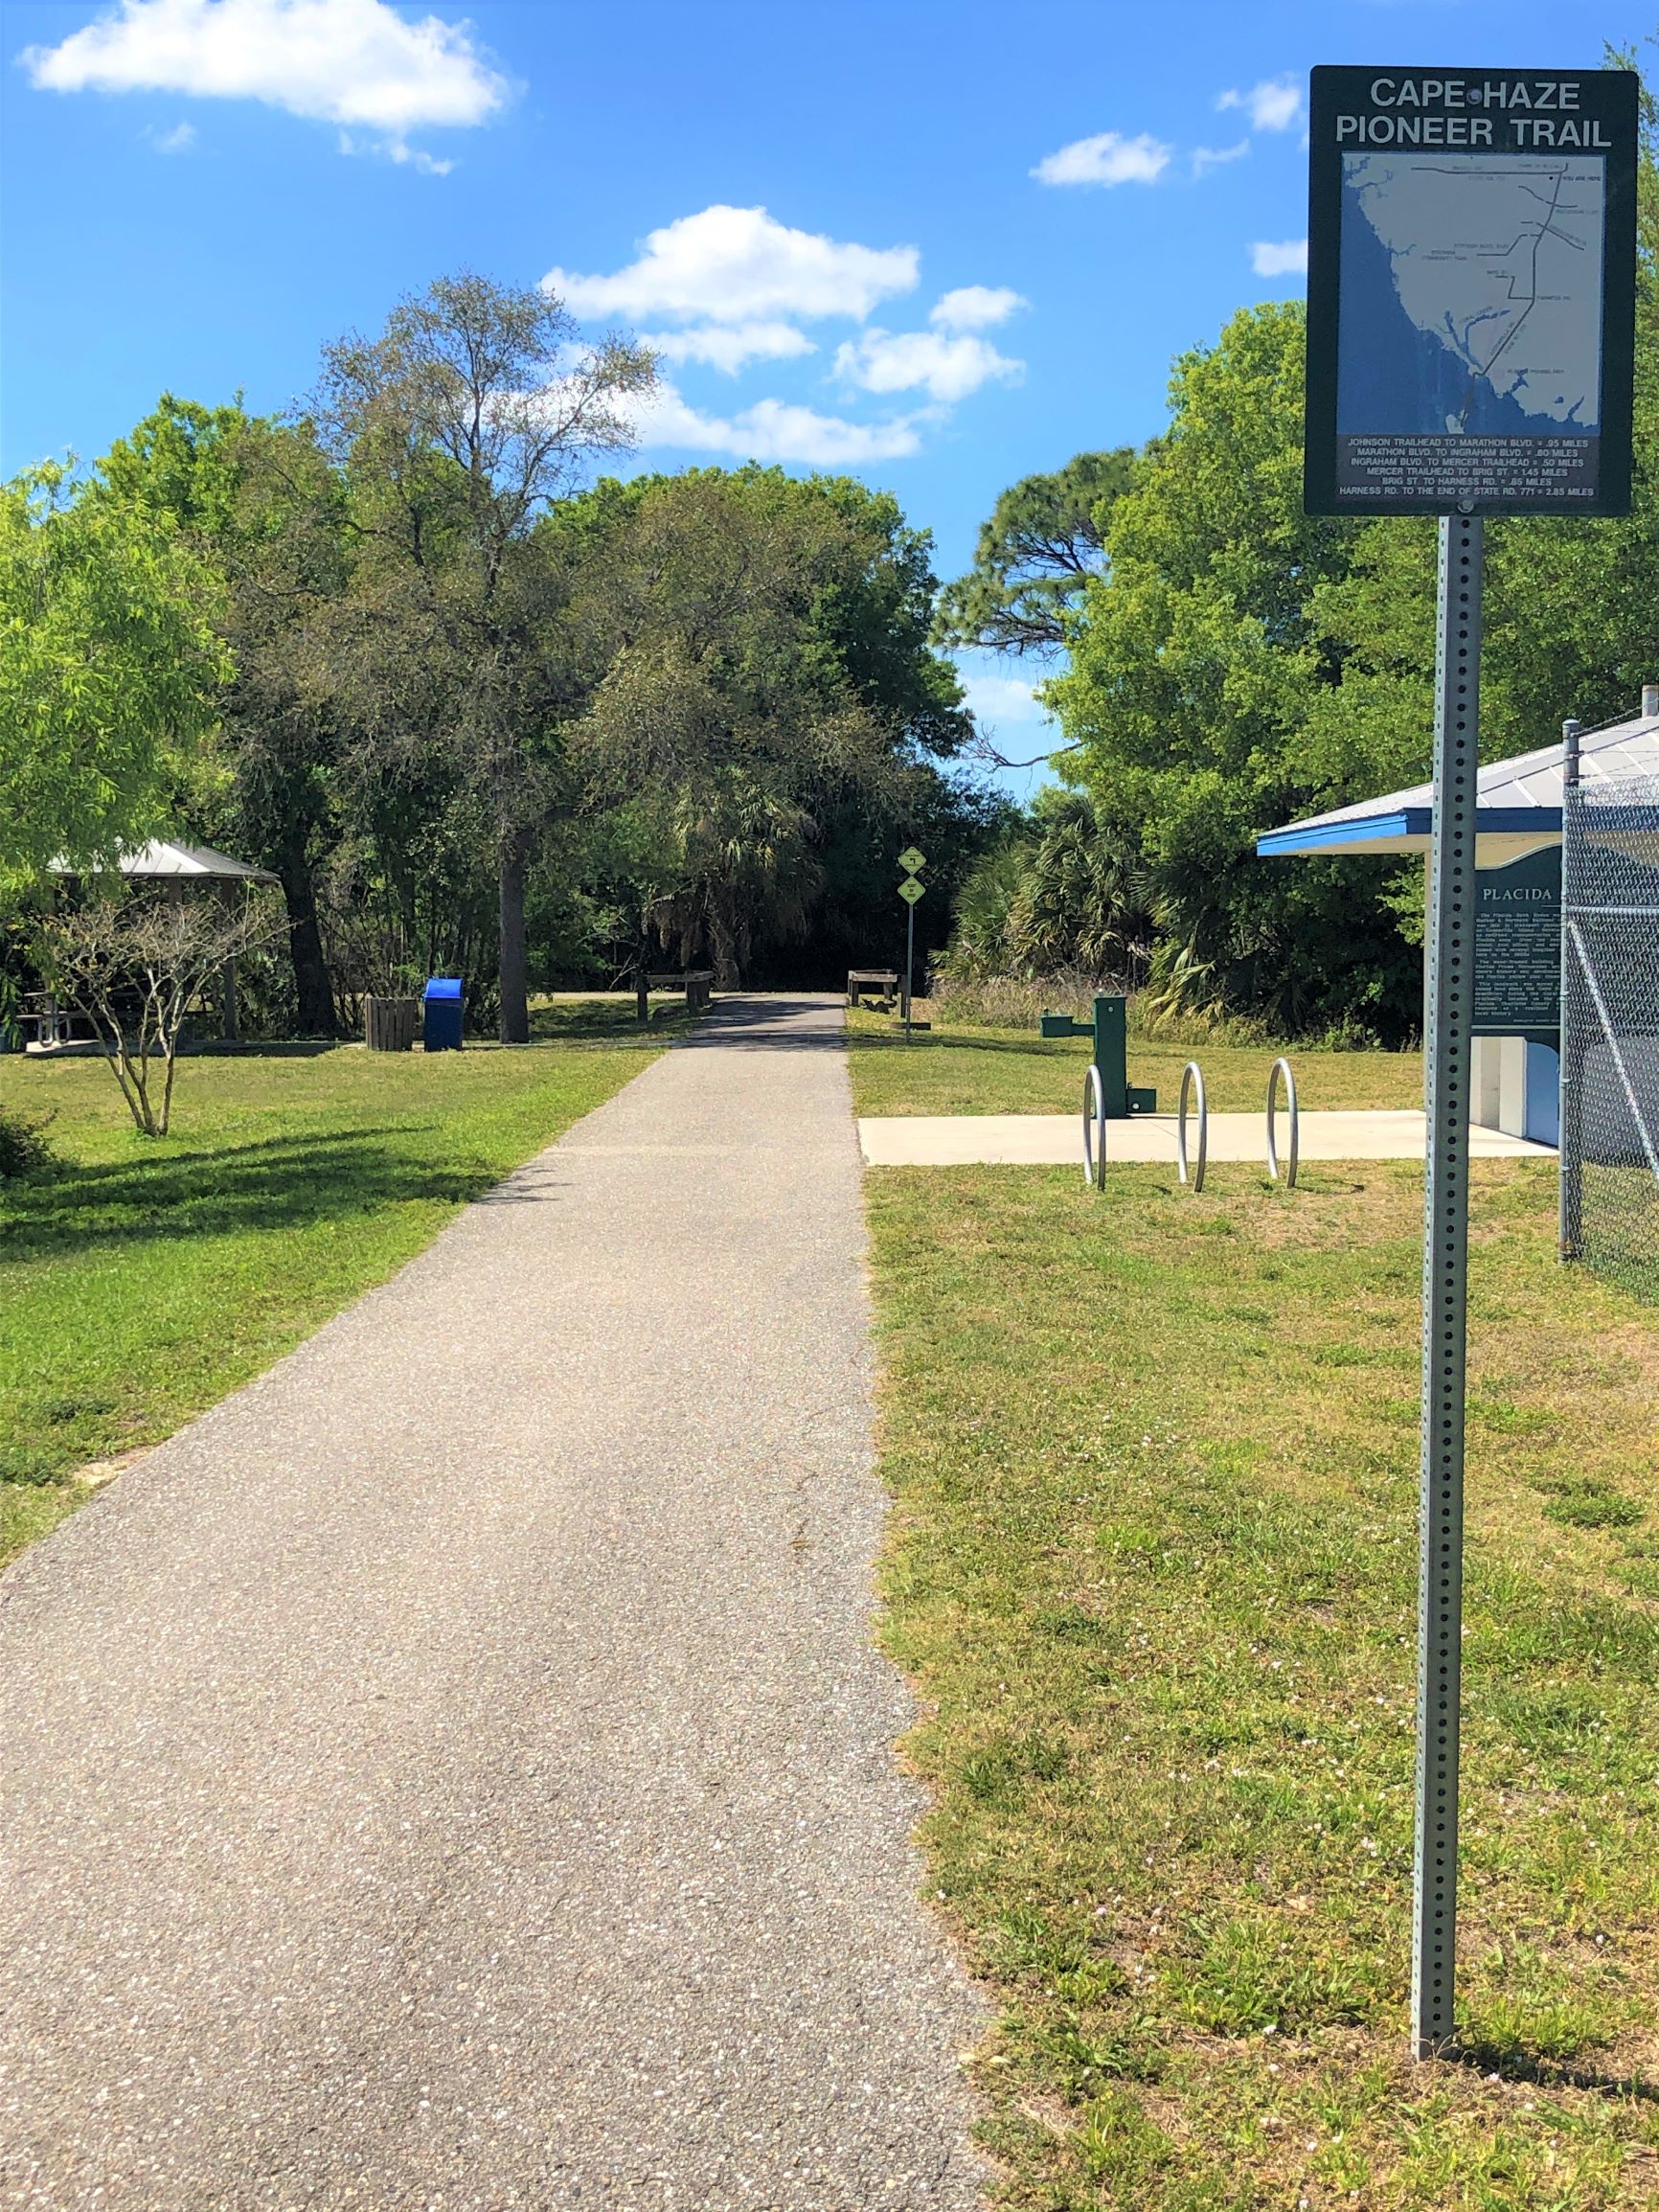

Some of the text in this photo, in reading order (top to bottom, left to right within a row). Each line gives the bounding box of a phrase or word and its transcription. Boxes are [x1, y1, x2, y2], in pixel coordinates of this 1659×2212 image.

[1371, 79, 1580, 109] CAPE HAZE
[1335, 116, 1612, 147] PIONEER TRAIL
[1348, 438, 1390, 446] JOHNSON
[1395, 438, 1441, 446] TRAILHEAD
[1558, 459, 1584, 467] MILES
[1407, 467, 1454, 476] TRAILHEAD
[1458, 467, 1469, 476] TO
[1541, 468, 1568, 477] MILES
[1526, 478, 1552, 487] MILES
[1340, 487, 1381, 495] HARNESS
[1567, 488, 1594, 496] MILES
[1483, 888, 1552, 901] PLACIDA
